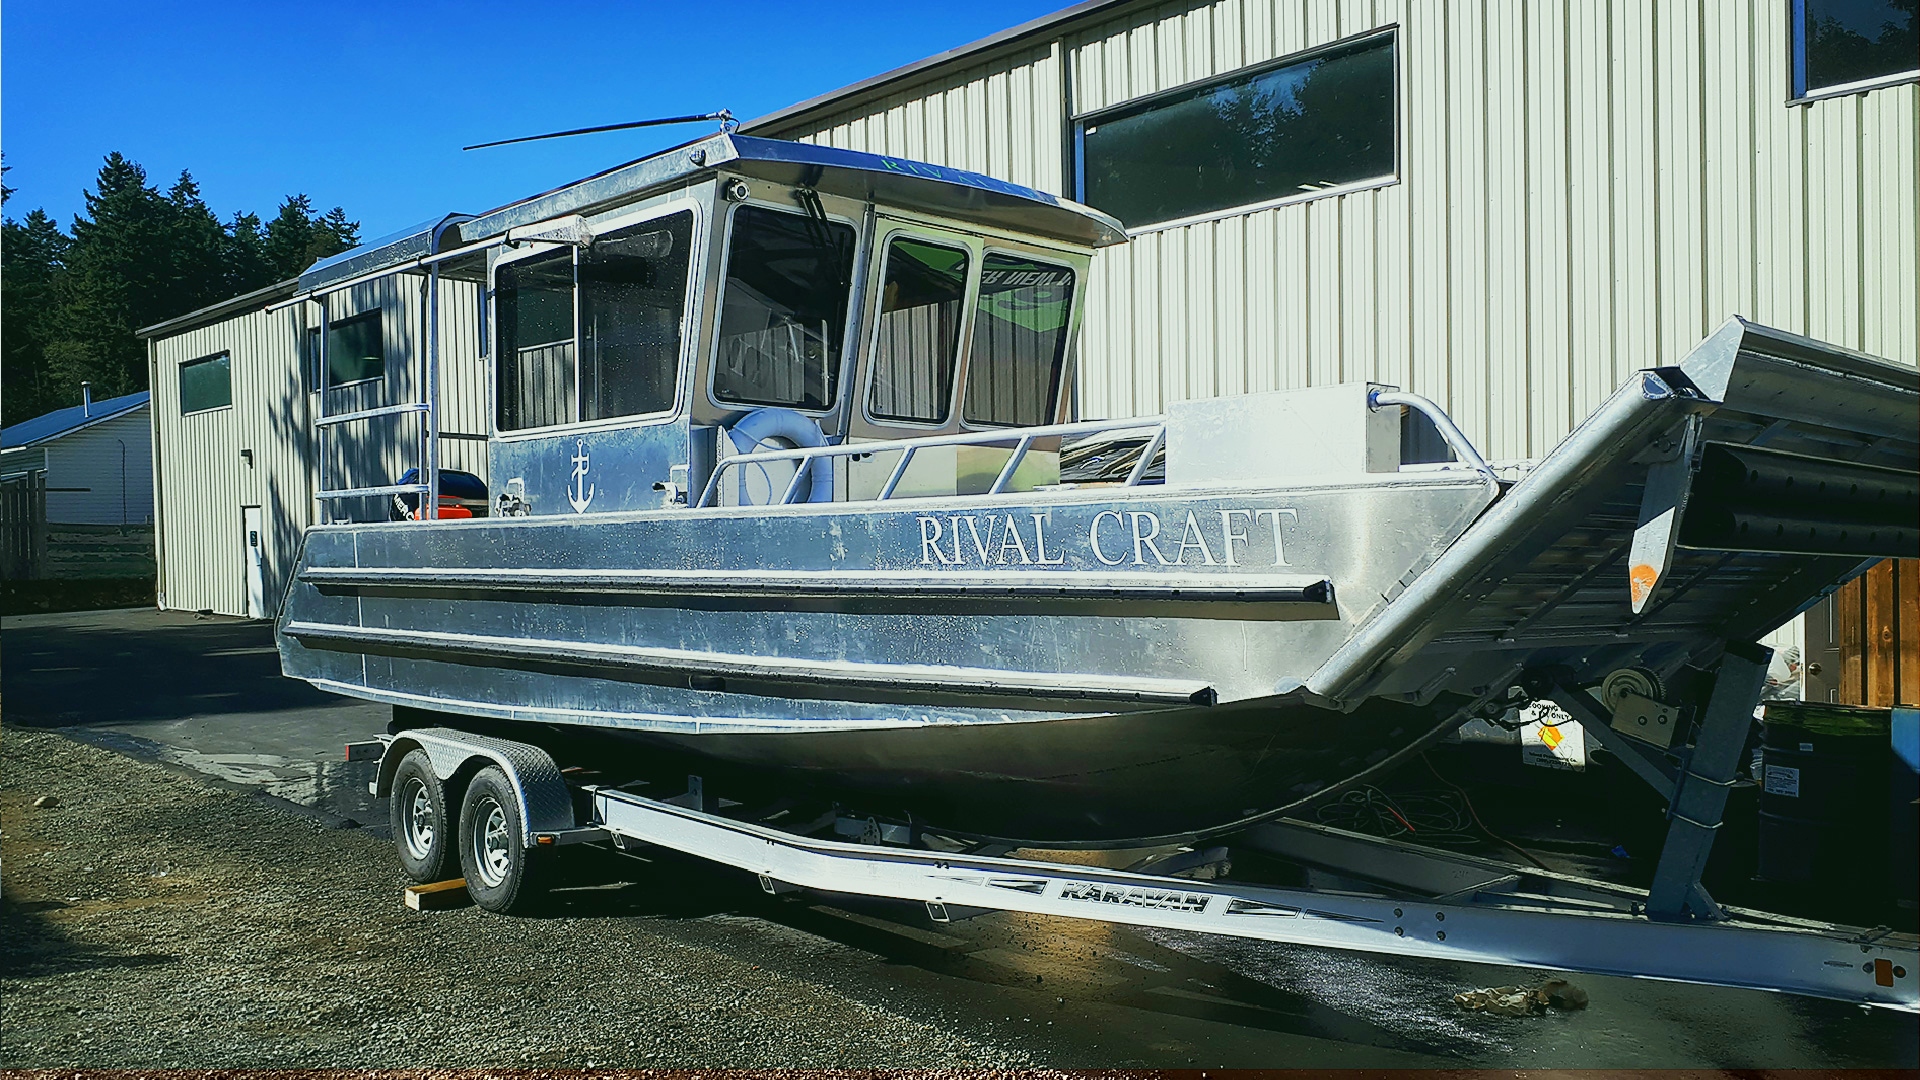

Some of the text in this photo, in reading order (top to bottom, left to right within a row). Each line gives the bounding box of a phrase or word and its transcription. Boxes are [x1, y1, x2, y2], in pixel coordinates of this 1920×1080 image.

[916, 509, 1300, 567] RIVAL CRAFT
[1058, 881, 1213, 914] KARAVAN
